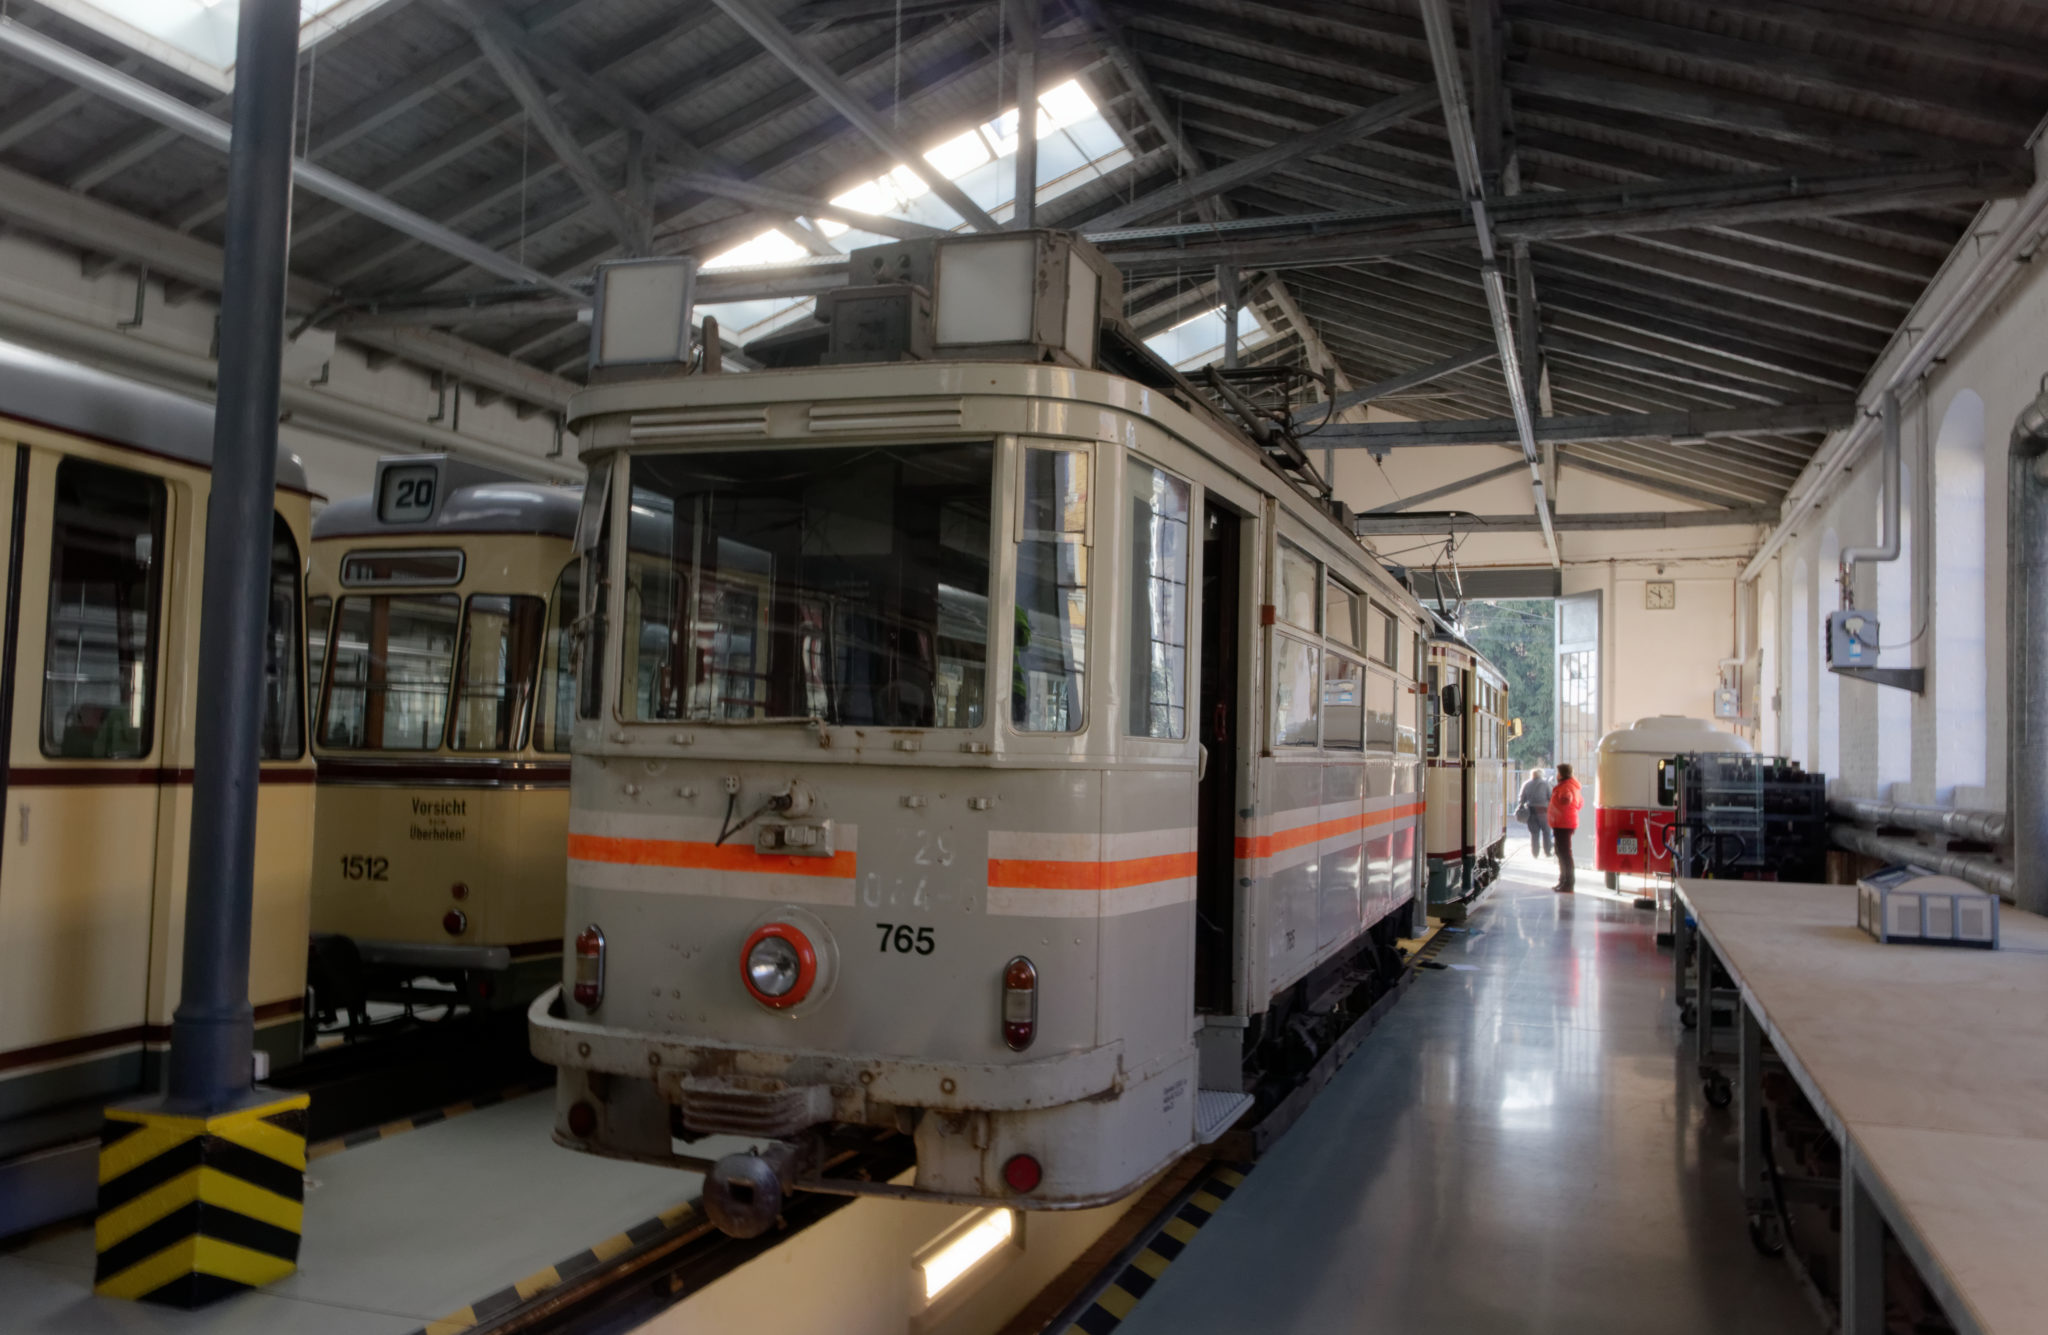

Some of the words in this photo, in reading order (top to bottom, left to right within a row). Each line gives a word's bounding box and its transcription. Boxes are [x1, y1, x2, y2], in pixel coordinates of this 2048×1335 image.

[396, 479, 433, 509] 20
[411, 797, 466, 816] Vorsicht
[341, 855, 389, 881] 1512
[876, 923, 935, 956] 765
